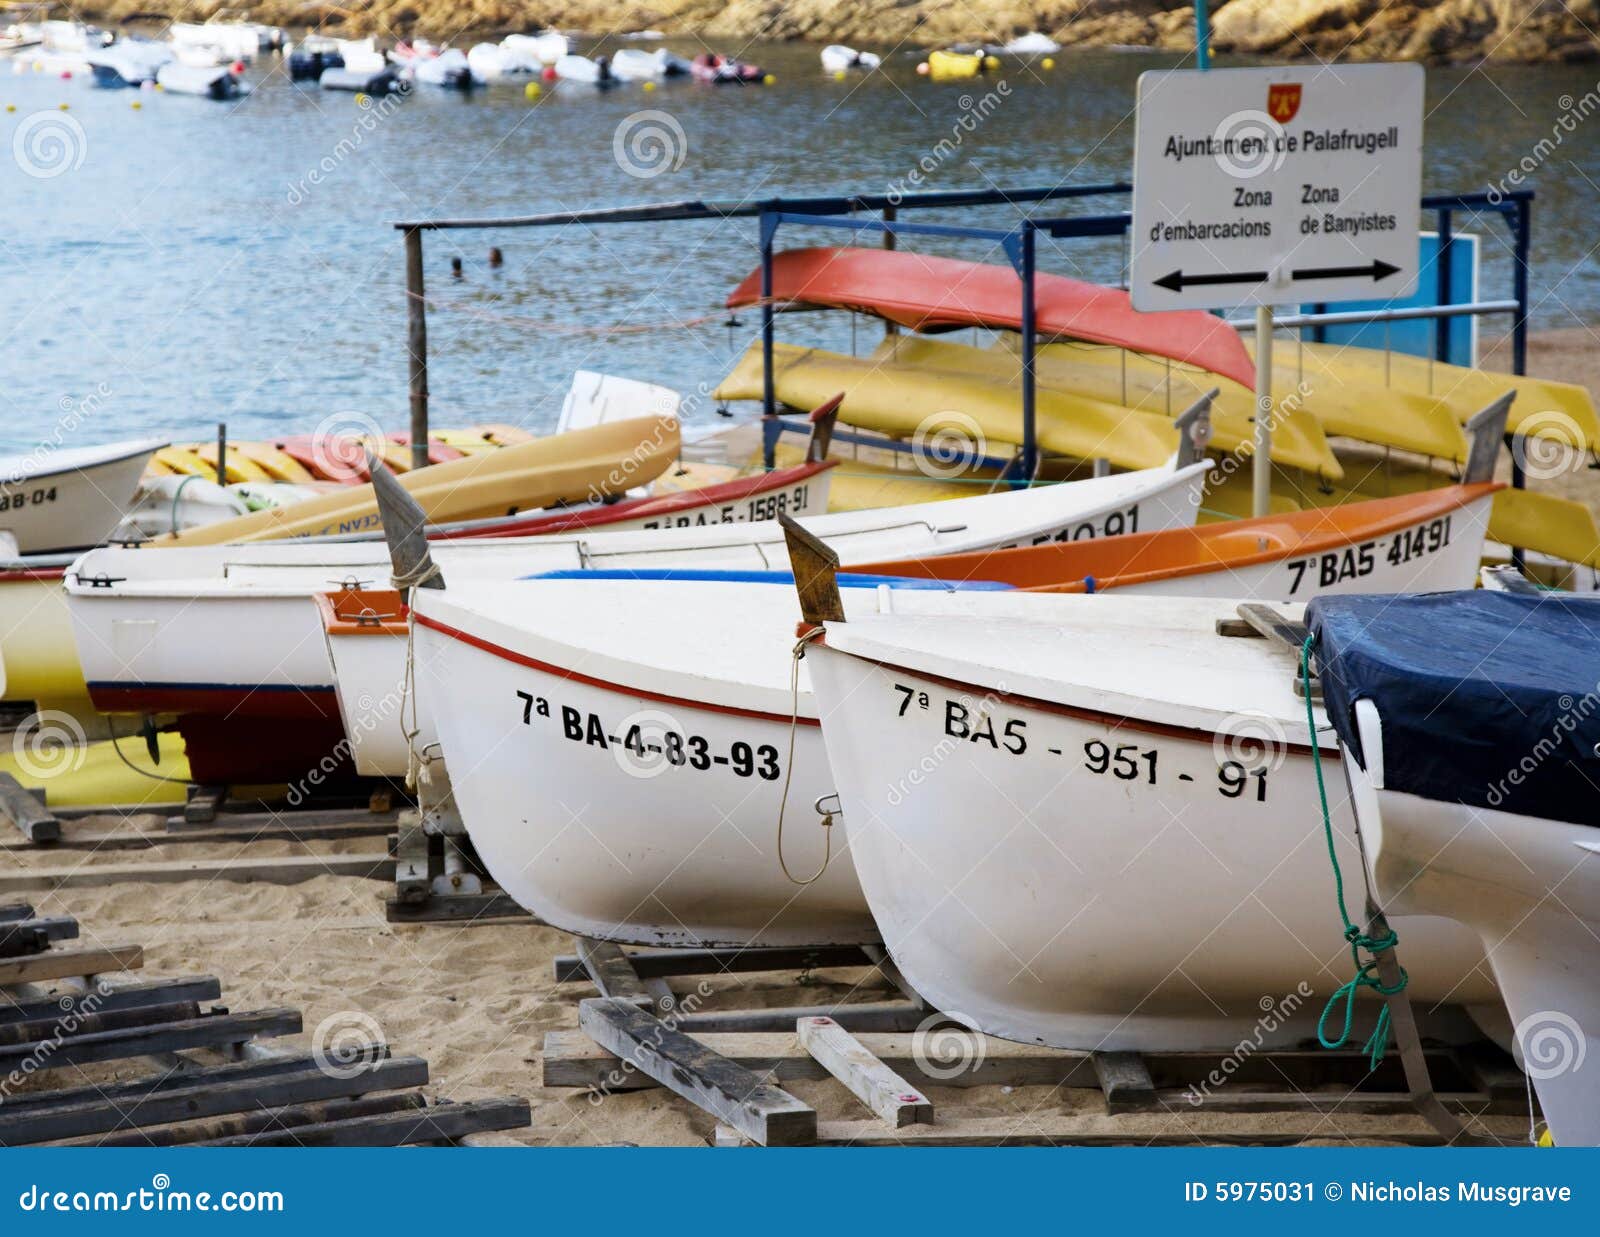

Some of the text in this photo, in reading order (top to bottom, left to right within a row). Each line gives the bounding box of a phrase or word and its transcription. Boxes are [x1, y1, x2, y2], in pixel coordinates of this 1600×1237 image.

[1164, 127, 1398, 161] Ajuntament de Palafrugell
[1234, 187, 1272, 207] Zona
[1302, 184, 1339, 204] Zona
[1150, 216, 1271, 242] d'embarcacions
[1300, 212, 1396, 236] de Banyistes
[339, 513, 383, 534] CEAN
[516, 690, 781, 781] 7ª BA-4-83-93
[894, 684, 930, 717] 7ª
[945, 700, 1028, 755] BA5
[1083, 740, 1158, 784] 951
[1217, 760, 1268, 802] 91
